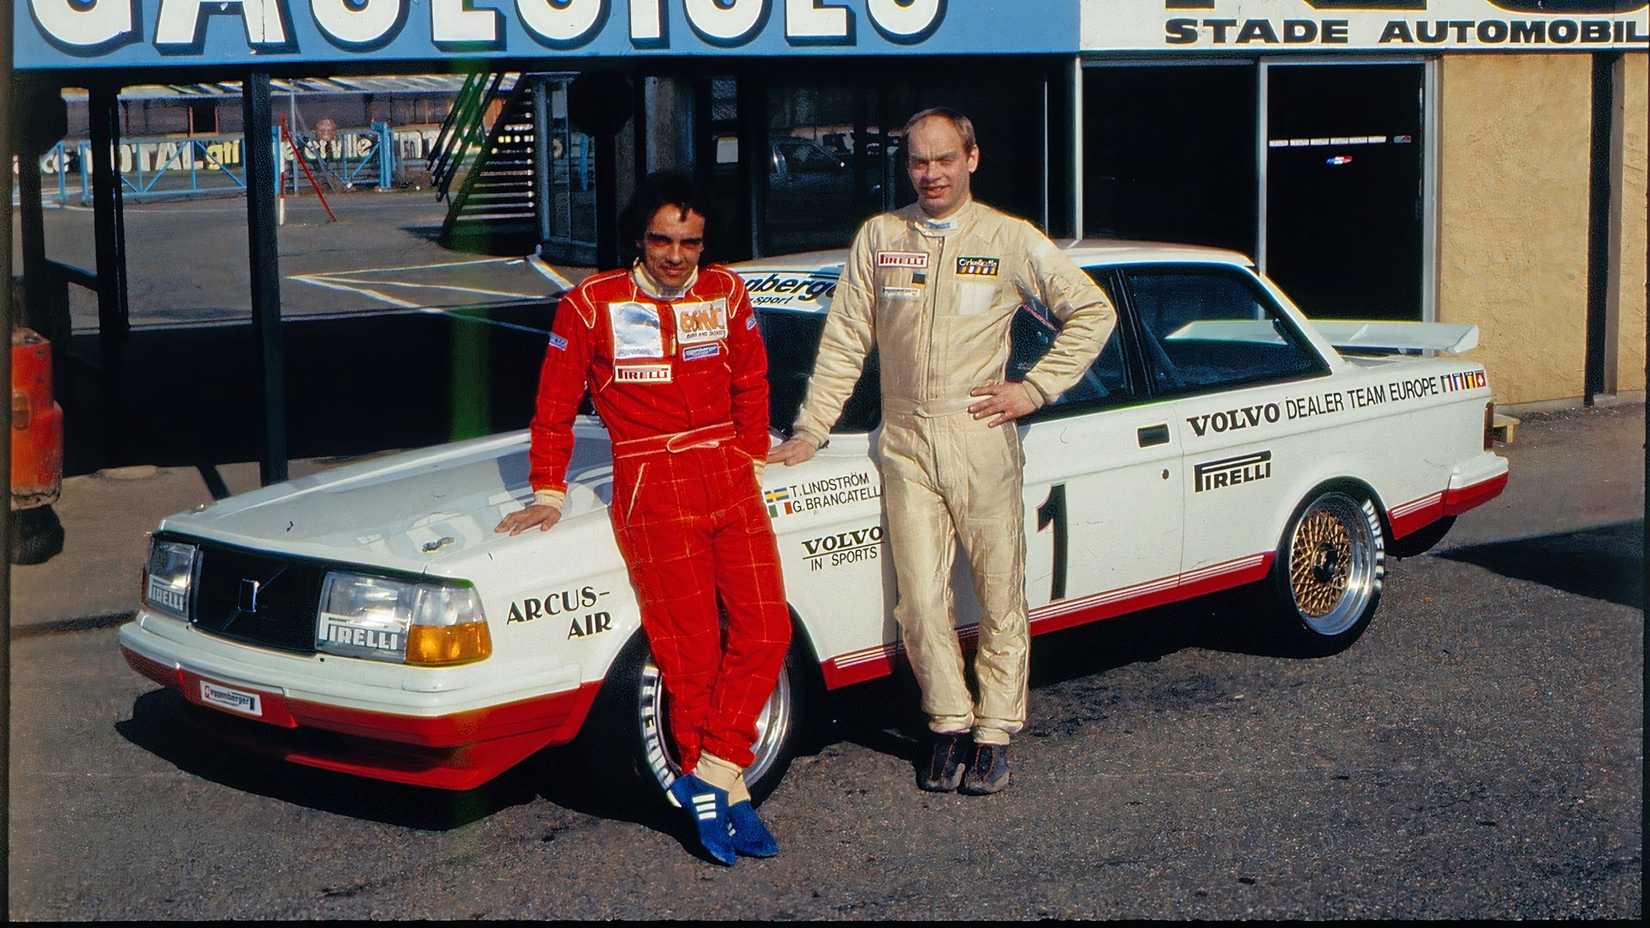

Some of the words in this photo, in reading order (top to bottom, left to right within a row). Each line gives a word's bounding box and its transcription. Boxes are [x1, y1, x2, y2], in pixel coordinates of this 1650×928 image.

[1166, 19, 1348, 43] STADE
[1378, 20, 1648, 43] AUTOMOBIL
[617, 367, 669, 380] PIRELLI
[1186, 403, 1280, 436] VOLVO
[1285, 393, 1344, 419] DEALER
[1347, 385, 1386, 409] TEAM
[1390, 377, 1438, 401] EUROPE
[1194, 450, 1272, 492] PIRELLI
[801, 526, 884, 555] VOLVO
[811, 557, 823, 571] IN
[831, 546, 878, 567] SPORTS
[1037, 484, 1068, 600] 1
[149, 574, 186, 611] PIRELLI
[506, 586, 611, 625] ARCUS-
[318, 612, 402, 650] PIRELLI
[568, 612, 613, 640] AIR
